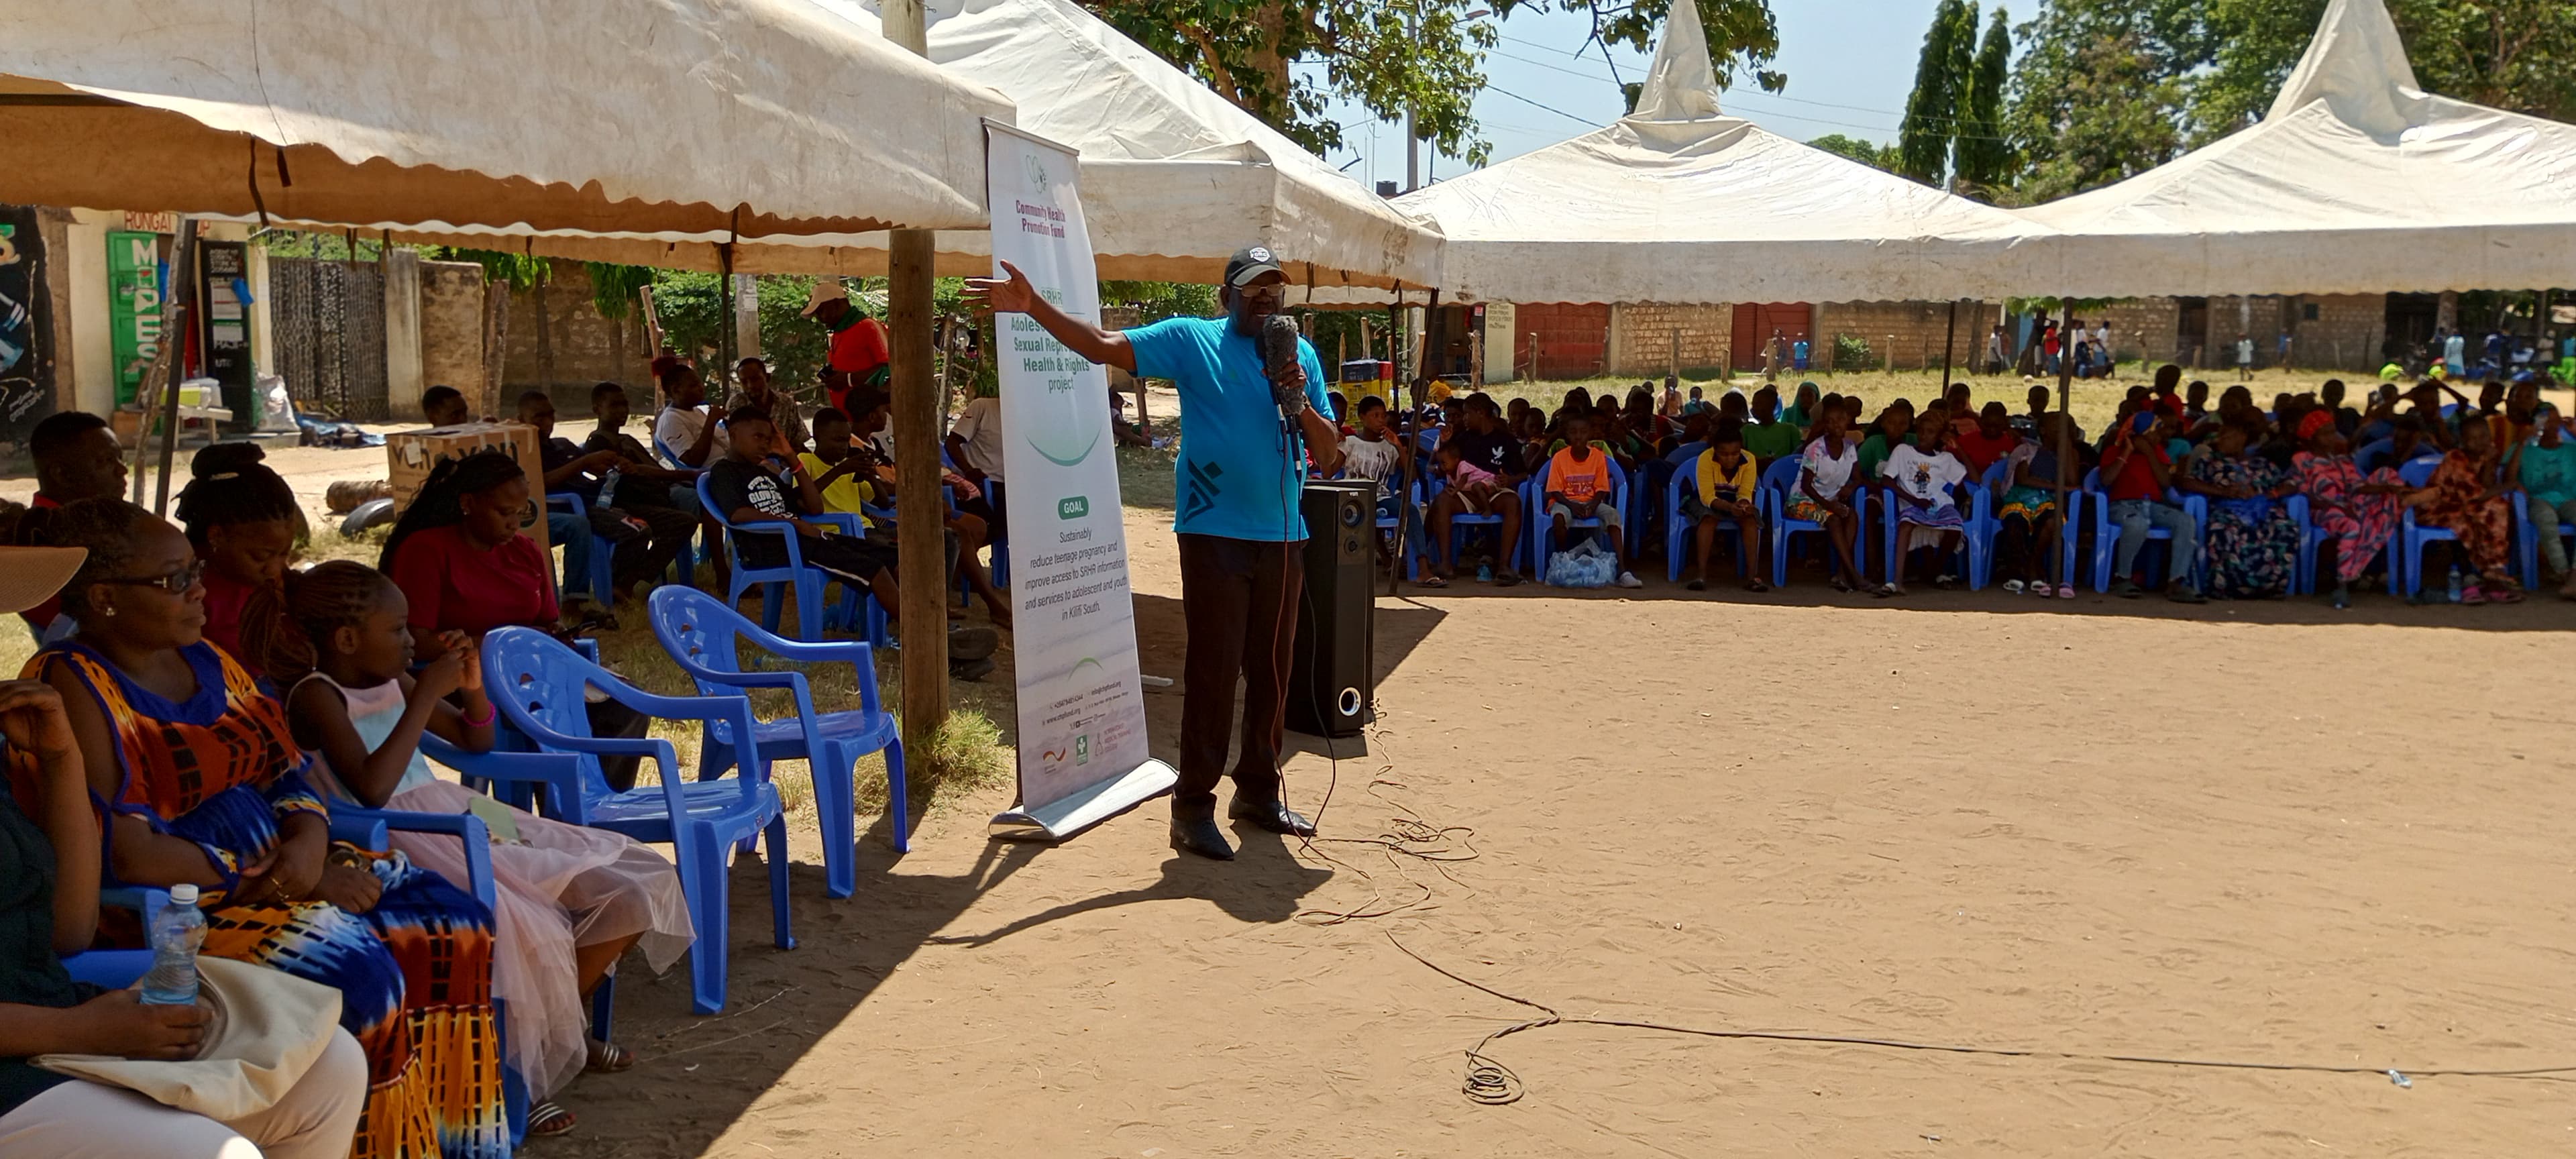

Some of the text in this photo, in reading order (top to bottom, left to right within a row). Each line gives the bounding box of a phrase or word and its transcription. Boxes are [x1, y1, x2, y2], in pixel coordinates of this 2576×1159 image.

[1016, 200, 1066, 223] Community Health
[1022, 218, 1065, 238] Promotion Fund
[1041, 290, 1063, 305] SRHR
[1011, 317, 1045, 332] Adoles
[1014, 337, 1043, 352] Sexual
[1024, 357, 1090, 375] Health & Rights
[1049, 376, 1074, 394] project
[749, 490, 771, 504] GLOW
[1063, 500, 1084, 514] GOAL
[1059, 527, 1092, 543] Sustainably
[1030, 540, 1118, 569] reduce teenage pregnancy and
[1025, 557, 1125, 591] improve access to SRHR information
[1025, 574, 1128, 610] and services to adolescent and youth
[1062, 608, 1068, 621] in
